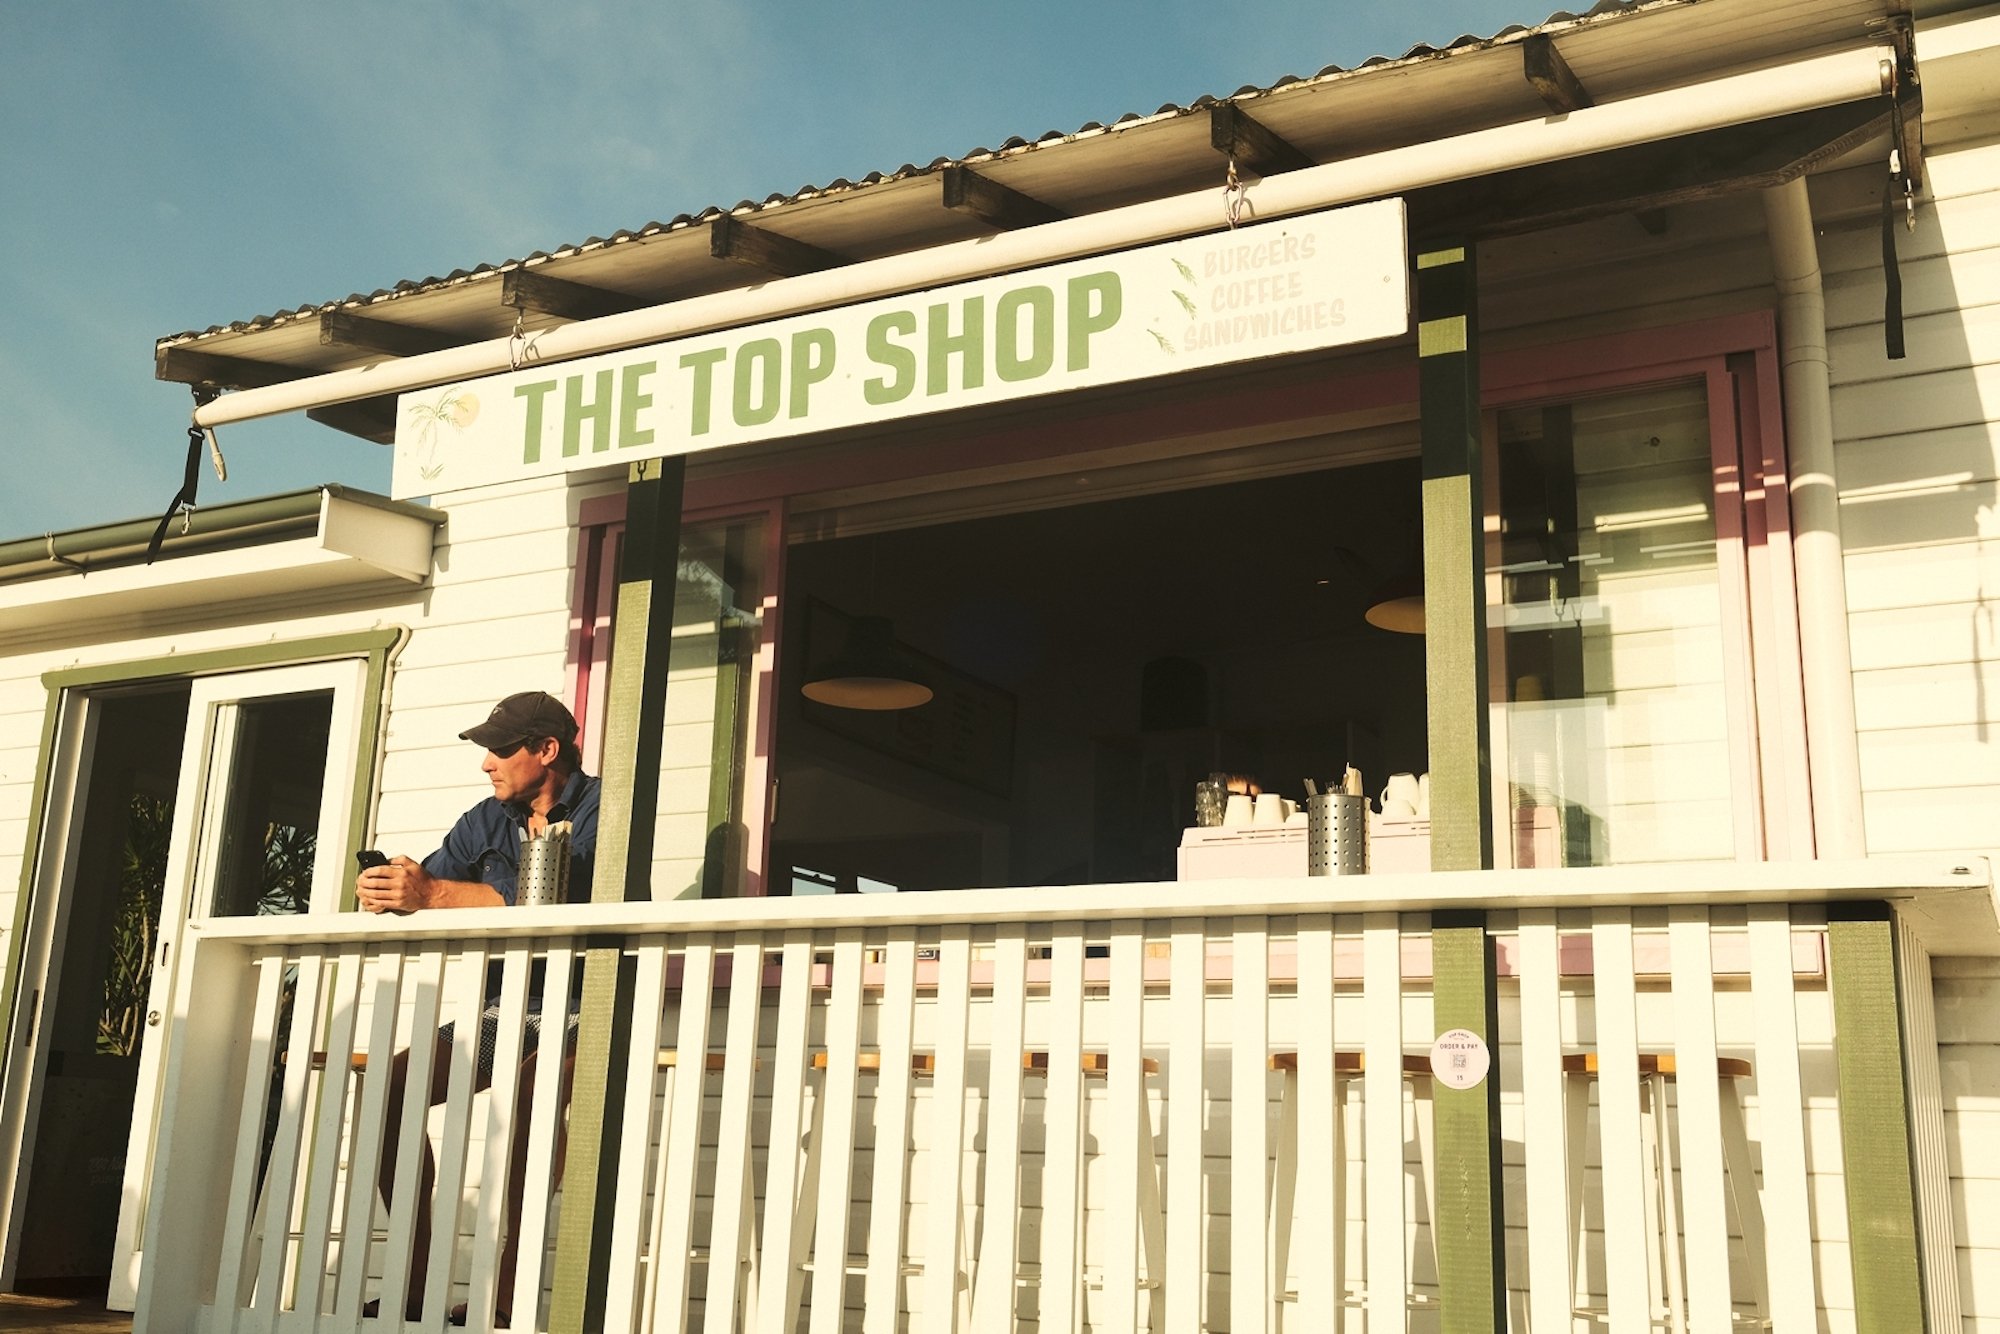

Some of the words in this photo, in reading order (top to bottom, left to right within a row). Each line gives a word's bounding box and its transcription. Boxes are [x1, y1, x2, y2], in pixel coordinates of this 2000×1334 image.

[1204, 233, 1317, 279] BURGERS
[1211, 271, 1304, 313] COFFEE
[1183, 298, 1347, 353] SANDWICHES
[514, 362, 657, 464] THE
[679, 328, 836, 436] TOP
[864, 271, 1122, 406] SHOP
